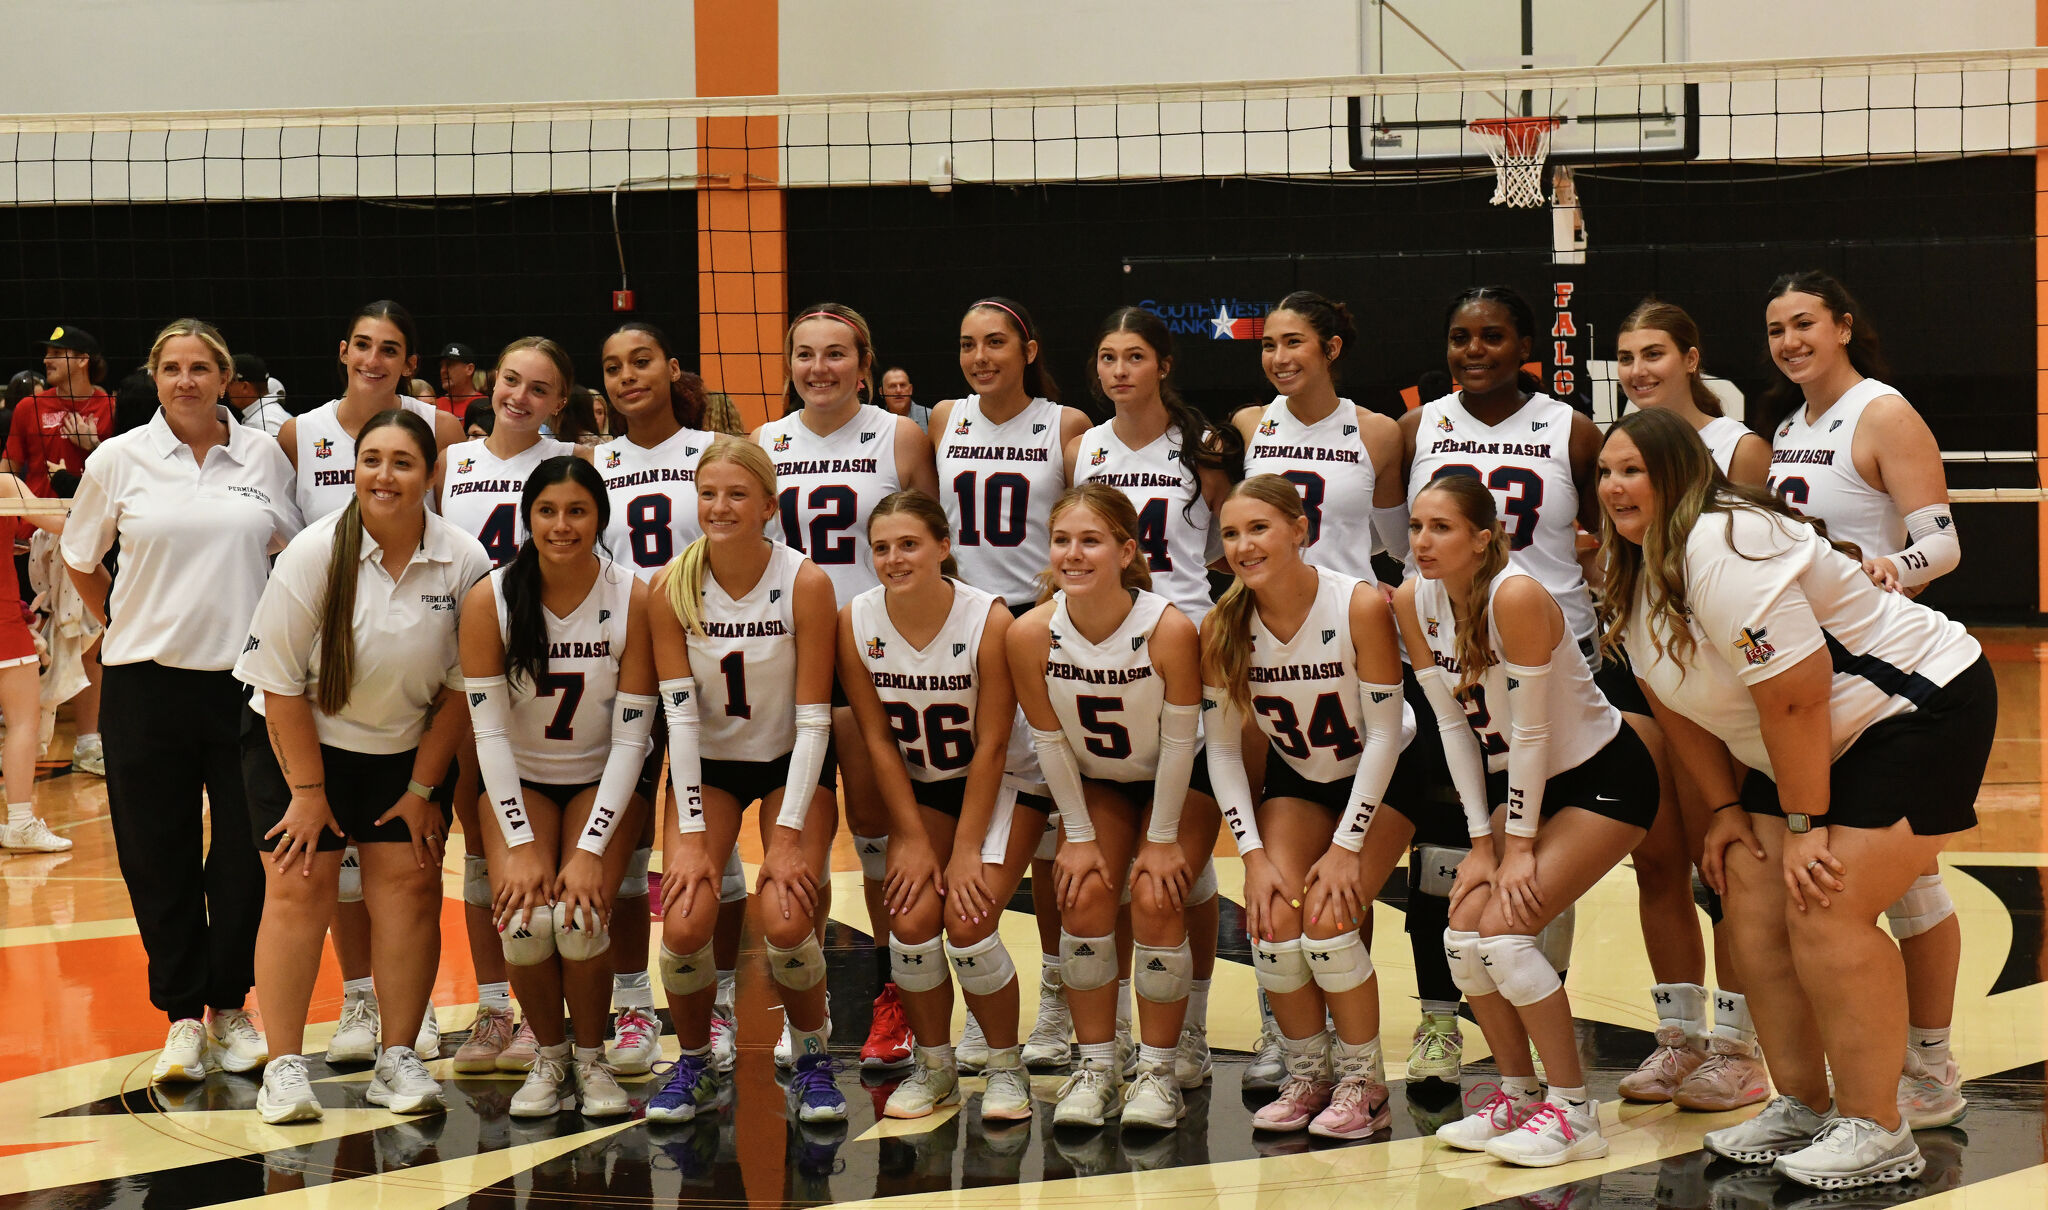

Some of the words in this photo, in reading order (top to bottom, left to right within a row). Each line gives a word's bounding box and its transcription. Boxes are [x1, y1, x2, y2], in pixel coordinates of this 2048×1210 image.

[1165, 319, 1208, 334] ANK
[946, 445, 1005, 460] PERMIAN
[1006, 446, 1048, 462] BASIN
[1253, 445, 1314, 460] PERMIAN
[1316, 449, 1359, 463] BASIN
[1431, 439, 1500, 454] PERMIAN
[1503, 443, 1551, 458] BASIN
[1772, 450, 1804, 463] ERMIAN
[1800, 450, 1835, 465] BASIN
[662, 469, 696, 482] BASI
[832, 459, 877, 473] BASIN
[1141, 473, 1181, 487] BASIN
[450, 480, 511, 498] PERMIAN
[953, 470, 1030, 547] 10
[1431, 464, 1543, 551] 3
[477, 503, 519, 570] 4
[627, 493, 673, 568] 8
[778, 484, 858, 565] 12
[1137, 497, 1173, 572] 4
[1900, 551, 1928, 570] FCA
[421, 594, 452, 603] PERMIAN
[1748, 646, 1770, 660] FCA
[720, 651, 751, 720] 1
[871, 672, 927, 691] ERMIAN
[929, 674, 972, 691] BASIN
[1046, 661, 1106, 685] PERMIAN
[1108, 666, 1152, 685] BASIN
[1248, 666, 1300, 683] ERMIAN
[1301, 662, 1345, 680] BASIN
[535, 672, 585, 741] 7
[881, 700, 976, 771] 26
[1076, 695, 1132, 760] 5
[1252, 692, 1364, 762] 34
[501, 797, 526, 830] FCA
[687, 785, 703, 818] FCA
[1509, 787, 1524, 820] FCA
[588, 806, 615, 838] FCA
[1225, 806, 1246, 841] FCA
[1350, 802, 1375, 833] FCA
